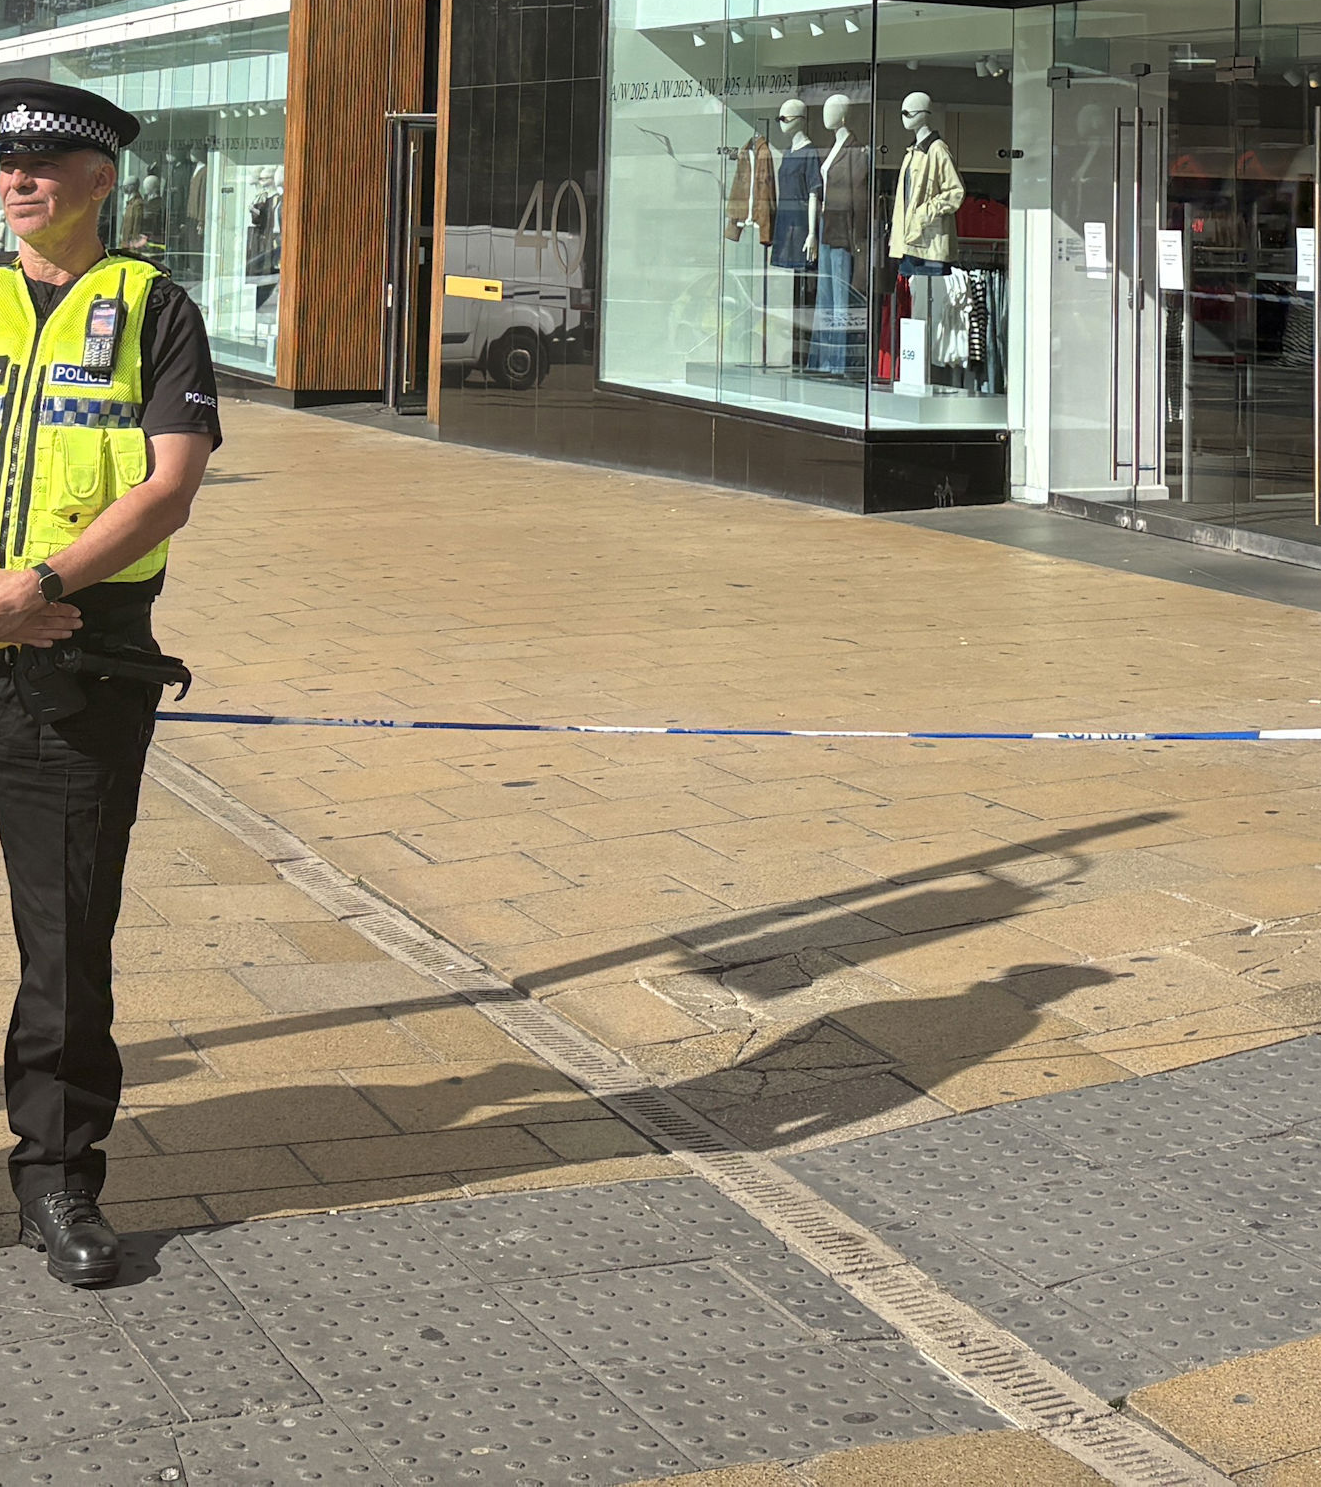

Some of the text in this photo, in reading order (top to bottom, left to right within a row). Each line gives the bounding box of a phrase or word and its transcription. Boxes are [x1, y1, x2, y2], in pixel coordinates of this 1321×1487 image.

[630, 81, 649, 100] 2025
[673, 79, 693, 98] 2025
[769, 74, 793, 94] 2025
[514, 179, 588, 274] 40
[54, 366, 108, 384] POLICE
[185, 391, 217, 409] POLICE
